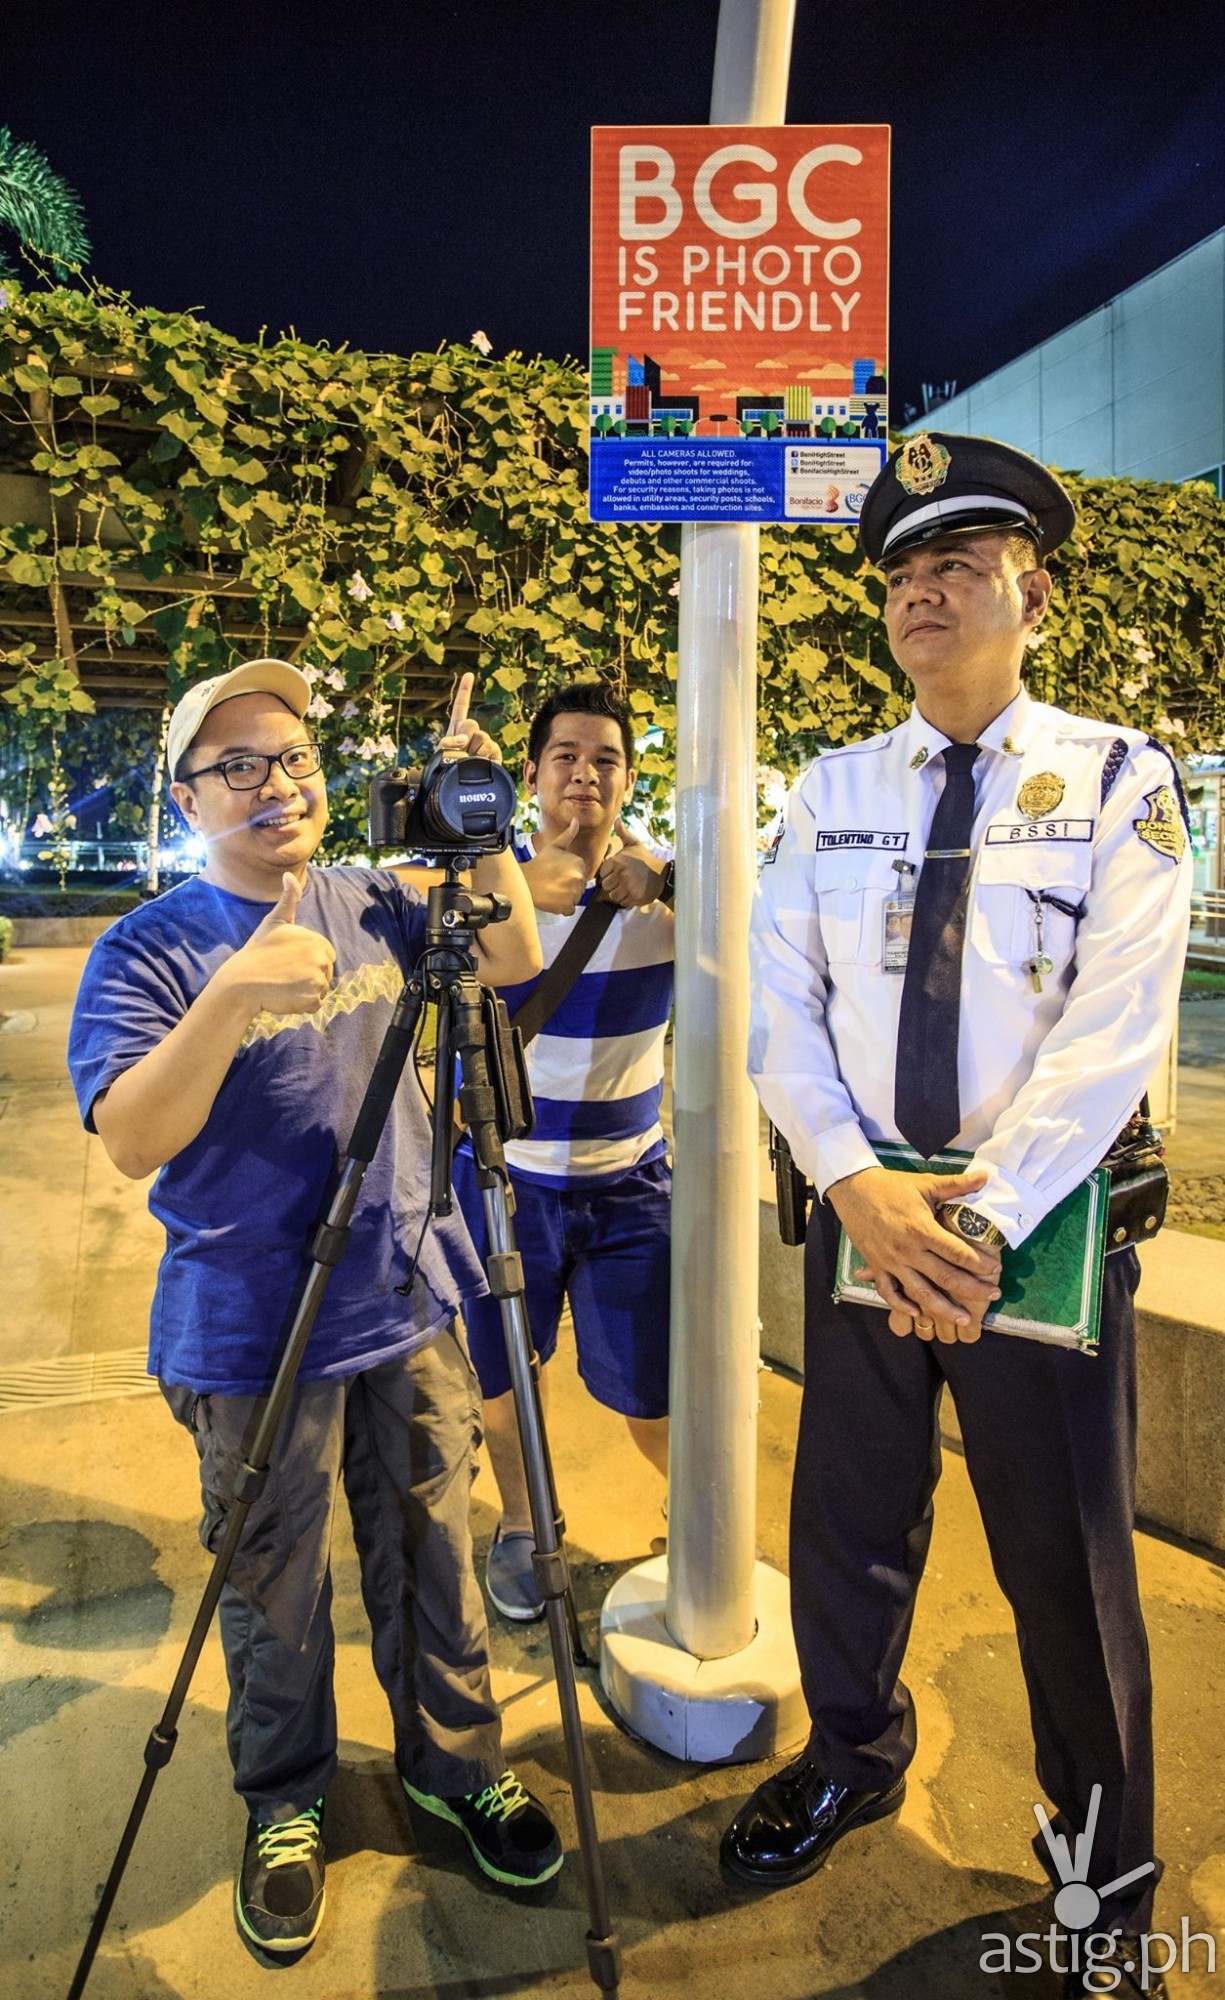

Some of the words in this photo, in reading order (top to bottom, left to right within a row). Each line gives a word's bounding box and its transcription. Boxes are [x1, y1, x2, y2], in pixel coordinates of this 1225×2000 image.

[619, 144, 863, 240] BGC
[619, 246, 659, 286] IS
[683, 245, 862, 286] PHOTO
[618, 291, 861, 332] FRIENDLY
[641, 449, 656, 458] ALL
[658, 449, 695, 458] CAMERAS
[697, 449, 737, 458] ALLOWED.
[624, 458, 656, 467] Permits,
[657, 458, 692, 467] however,
[707, 459, 740, 468] required
[628, 468, 673, 477] video/photo
[673, 468, 699, 476] shoots
[700, 468, 711, 476] for
[712, 468, 751, 477] weddings,
[620, 477, 647, 485] debuts
[647, 477, 662, 485] and
[663, 477, 683, 485] other
[684, 477, 729, 485] commercial
[612, 486, 627, 494] For
[628, 486, 659, 495] security
[659, 486, 692, 494] reasons,
[692, 486, 717, 495] taking
[717, 486, 743, 495] photos
[752, 486, 765, 494] not
[602, 494, 632, 503] allowed
[632, 494, 641, 502] in
[641, 495, 664, 504] utility
[664, 495, 689, 503] areas,
[689, 495, 720, 504] security
[744, 494, 776, 504] schools,
[789, 496, 824, 505] Bonifacio
[613, 503, 638, 512] banks,
[639, 503, 680, 512] embassies
[680, 503, 695, 512] and
[696, 503, 743, 512] construction
[744, 504, 765, 512] sites.
[459, 792, 497, 803] Canon
[1009, 822, 1069, 840] BSSI
[820, 833, 875, 846] TOLENTINO
